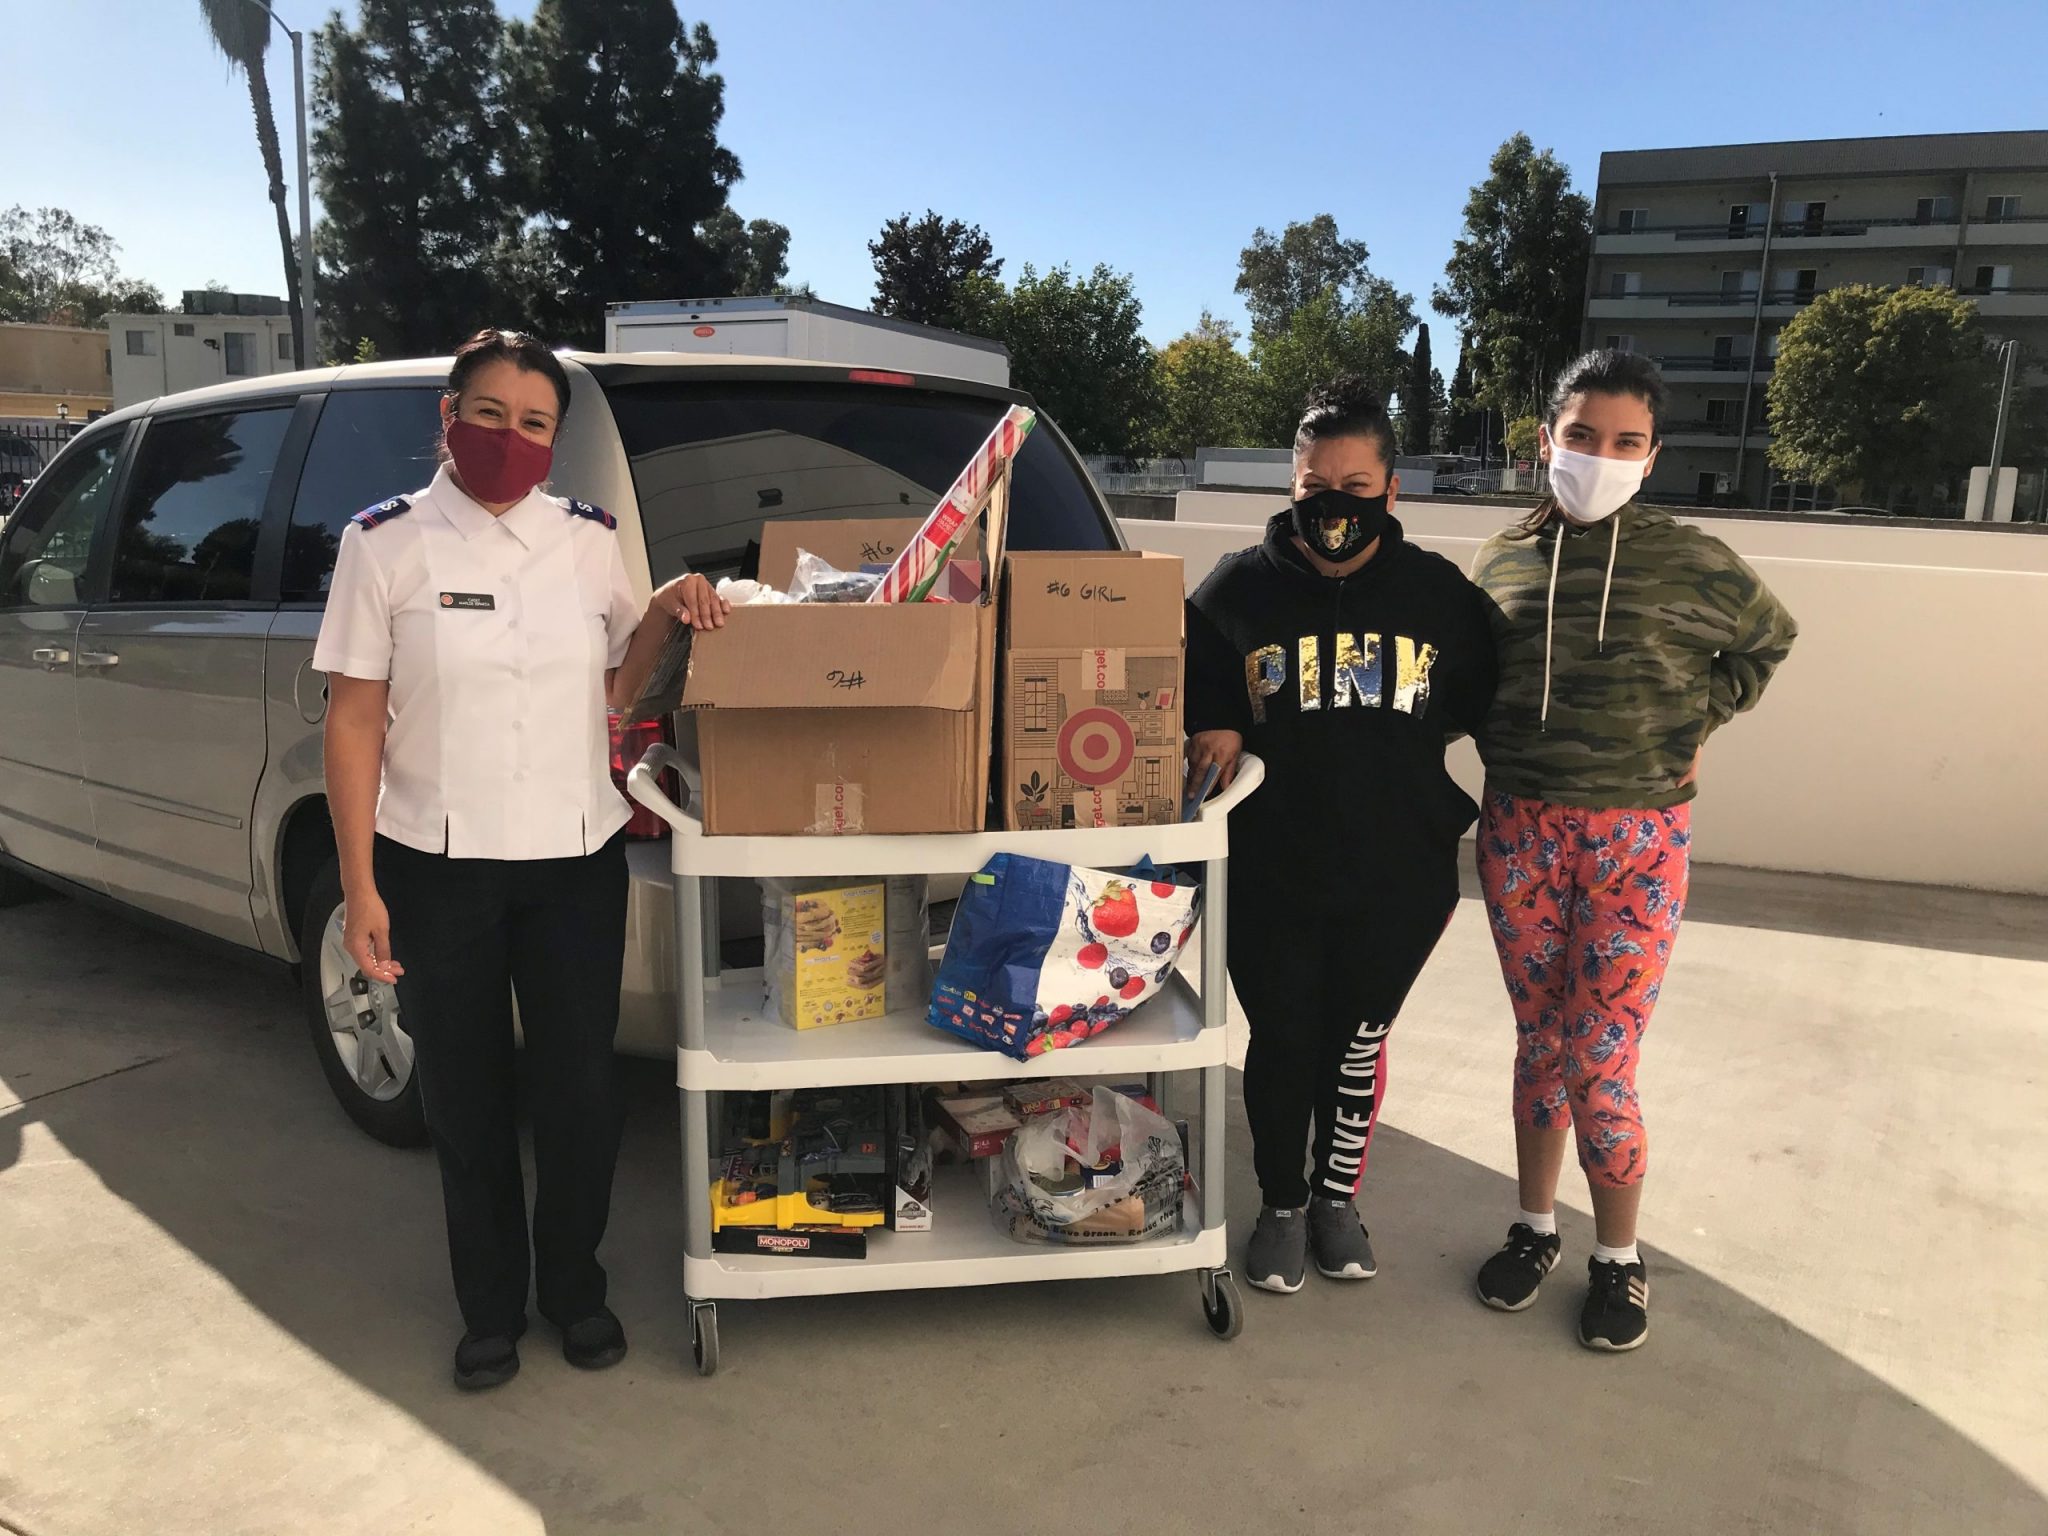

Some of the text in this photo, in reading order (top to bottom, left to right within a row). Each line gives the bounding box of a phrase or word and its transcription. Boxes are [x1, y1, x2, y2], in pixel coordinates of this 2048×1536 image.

[380, 501, 399, 511] S
[576, 501, 593, 513] S
[859, 540, 894, 561] #6
[1046, 580, 1126, 602] #6 GIRL
[1245, 632, 1439, 726] PINK
[1323, 1018, 1396, 1194] LOVE LOVE
[760, 1238, 808, 1247] MONOPOLY
